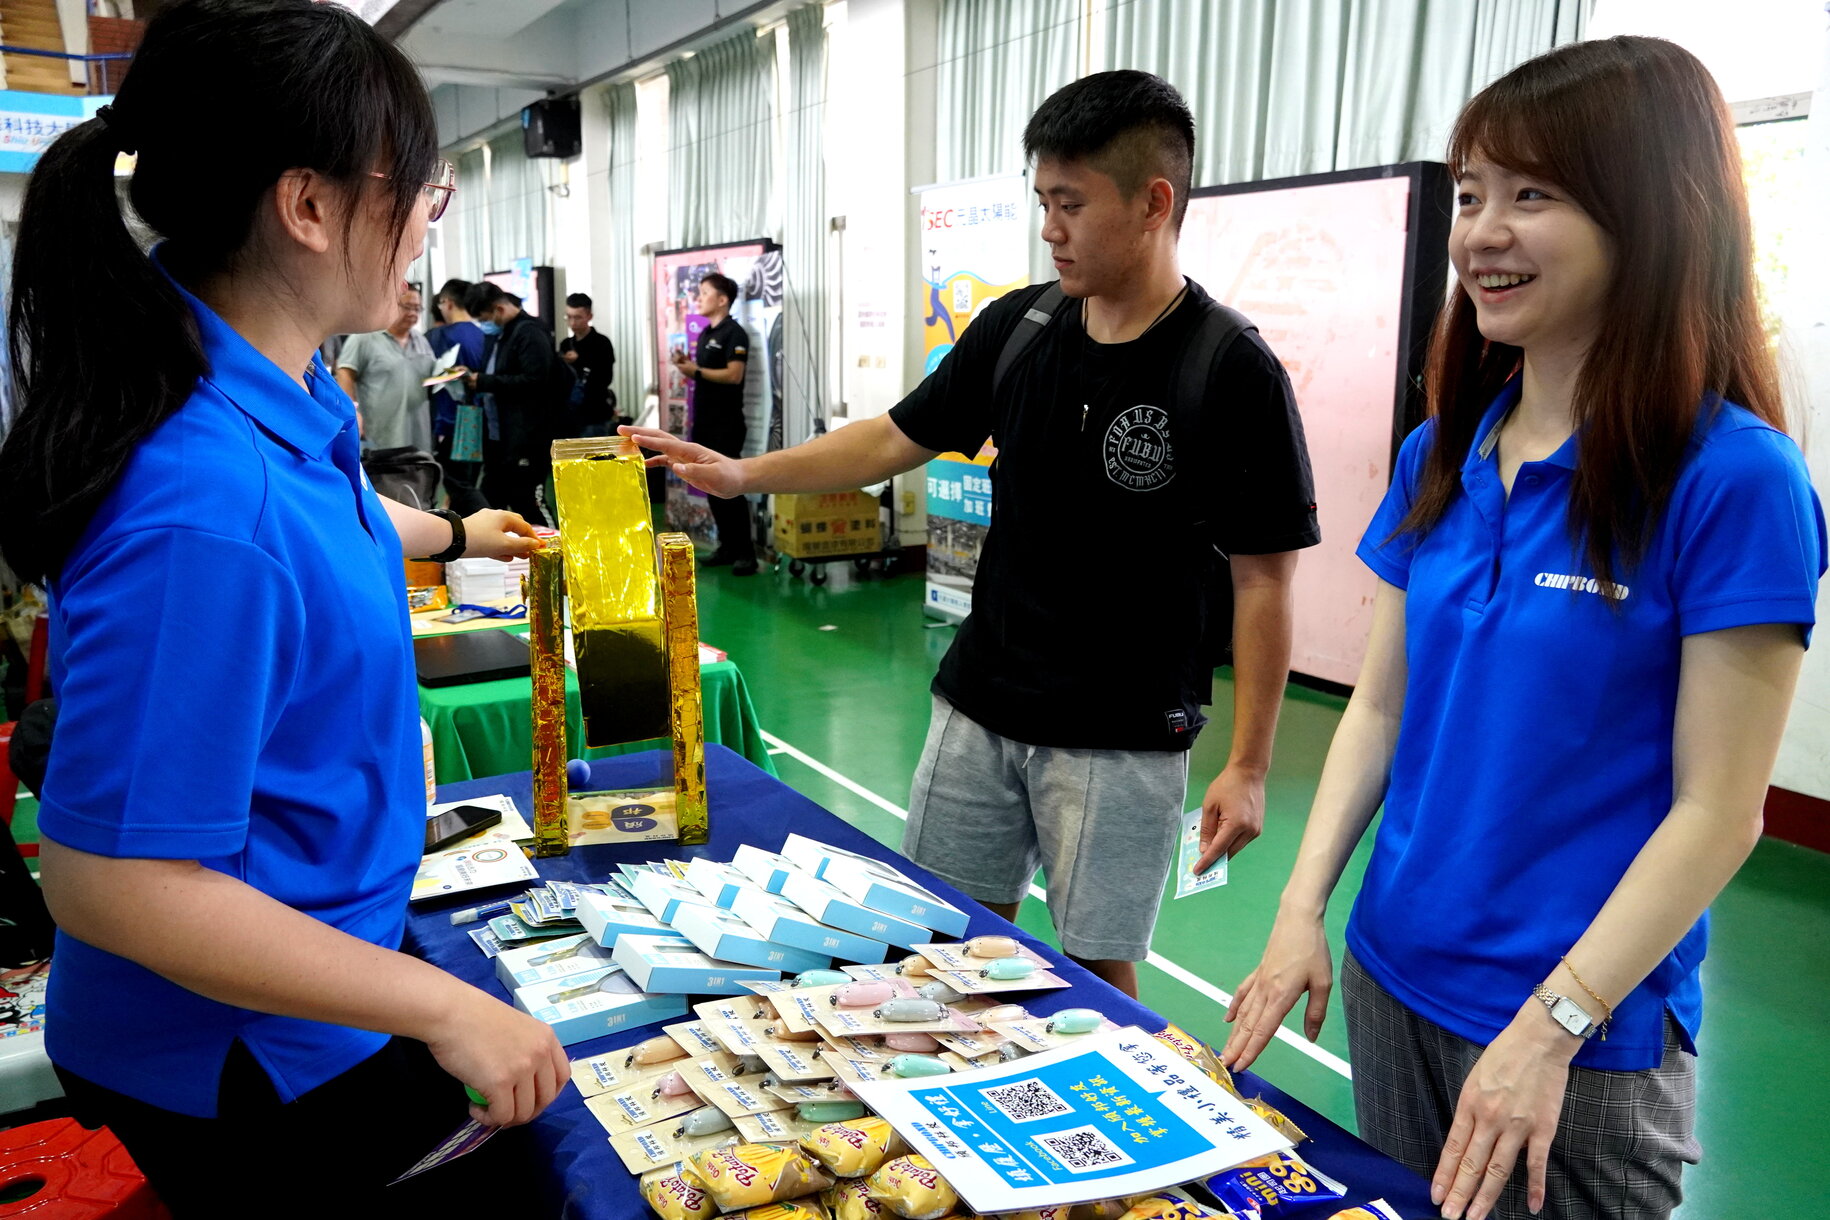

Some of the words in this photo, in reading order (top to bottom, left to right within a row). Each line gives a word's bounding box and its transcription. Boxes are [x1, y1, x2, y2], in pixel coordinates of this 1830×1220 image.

[1121, 436, 1162, 462] FUBU
[927, 476, 962, 503] 可選擇
[1534, 572, 1629, 601] CHIPBOD
[911, 1121, 957, 1160] CHIPBOND
[722, 1154, 756, 1188] Potato
[1025, 1140, 1064, 1172] Facebook
[902, 1163, 937, 1190] Potato
[1240, 1171, 1279, 1206] mini
